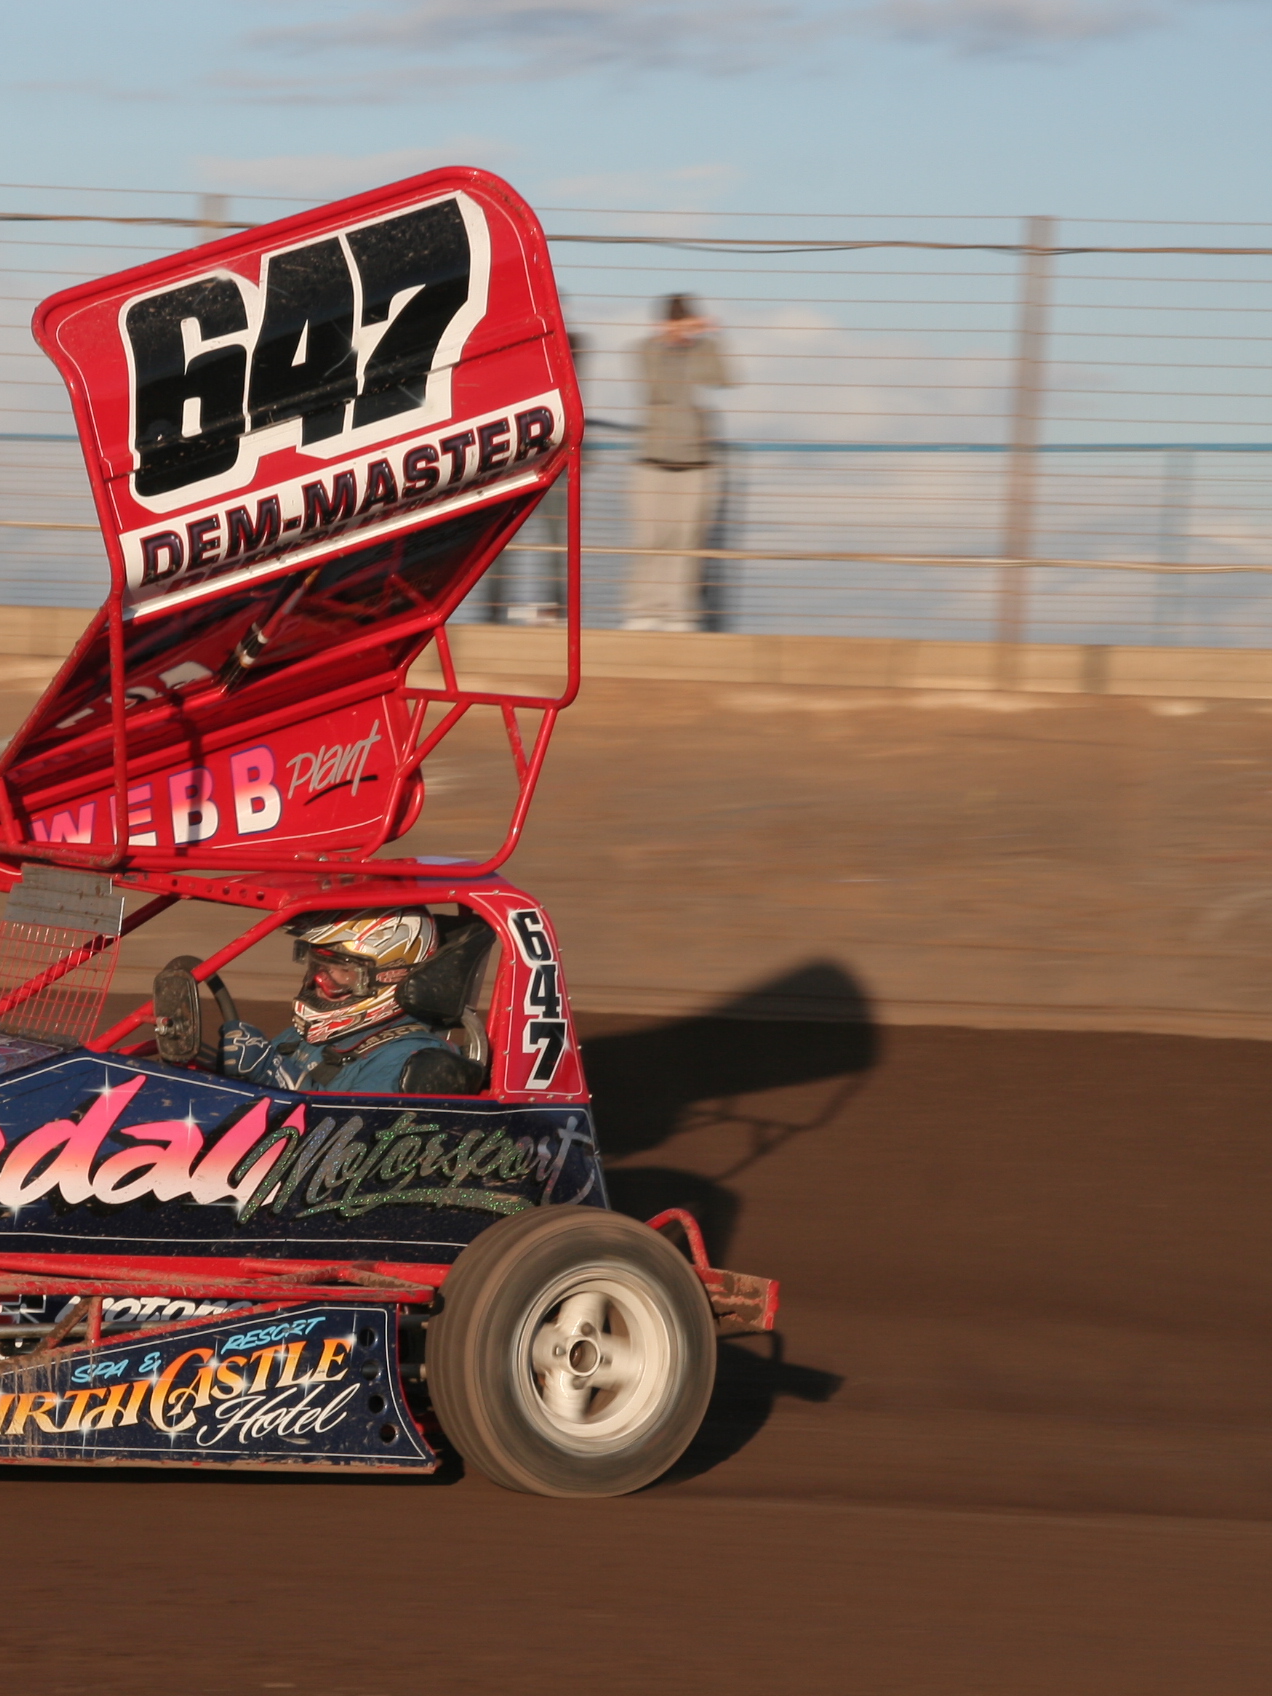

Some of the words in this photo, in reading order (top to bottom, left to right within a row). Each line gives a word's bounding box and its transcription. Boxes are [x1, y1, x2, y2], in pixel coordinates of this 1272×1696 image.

[121, 194, 480, 504] 647
[138, 405, 557, 587] DEM-MASTER
[32, 744, 283, 847] WEBB
[284, 719, 382, 800] Plant
[508, 909, 568, 1090] 647
[233, 1111, 594, 1226] Motorsport
[71, 1359, 129, 1385] SPA
[139, 1352, 162, 1374] &
[220, 1316, 327, 1356] RESORT
[149, 1337, 356, 1434] CASTLE
[195, 1383, 361, 1448] Hotel
